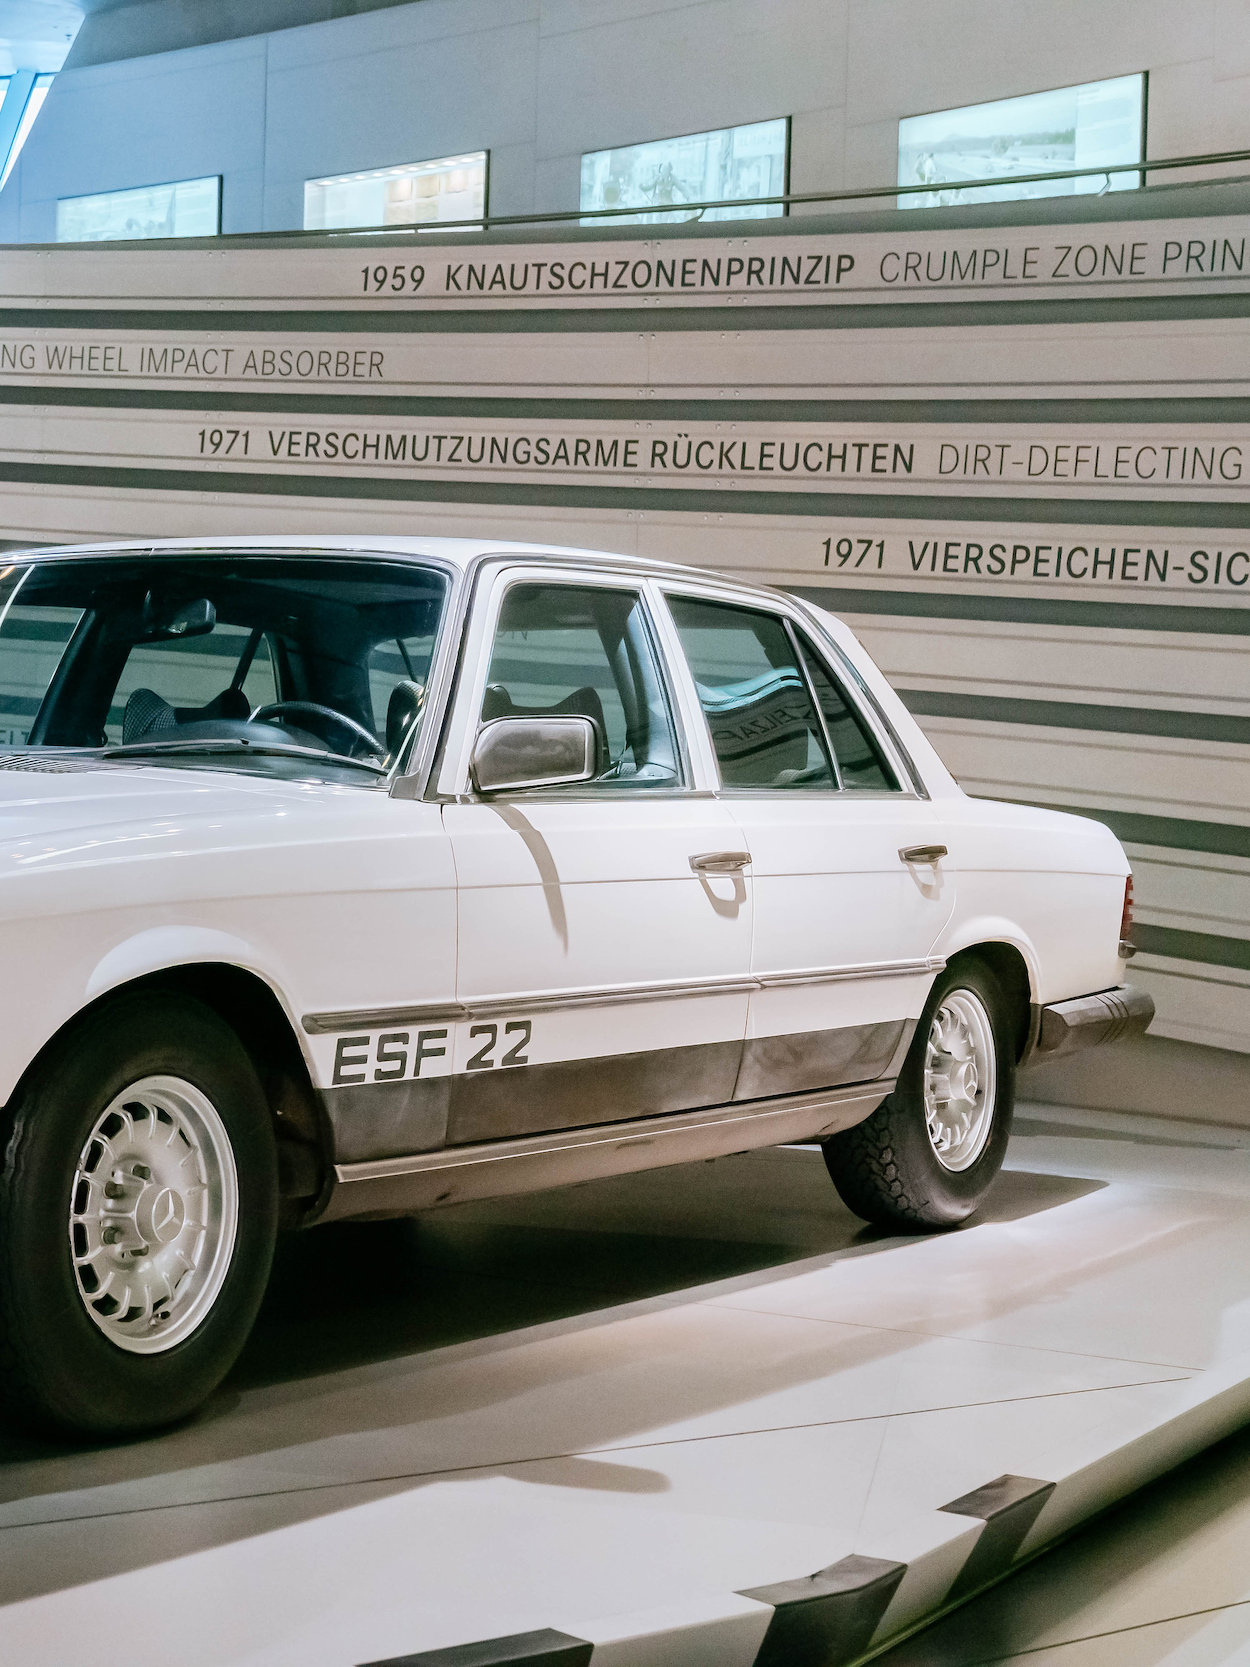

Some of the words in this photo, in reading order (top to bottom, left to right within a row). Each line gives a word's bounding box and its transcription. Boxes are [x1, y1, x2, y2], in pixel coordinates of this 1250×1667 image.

[360, 265, 426, 292] 1959
[445, 254, 855, 291] KNAUTSCHZONENPRINZIP
[879, 246, 1041, 283] CRUMPLE
[1051, 242, 1149, 278] ZONE
[1162, 238, 1246, 274] PRIN
[45, 344, 129, 373] WHEEL
[140, 347, 235, 375] IMPACT
[242, 350, 385, 379] ABSORBER
[197, 428, 251, 456] 1971
[268, 430, 640, 469] VERSCHMUTZUNGSARME
[650, 433, 915, 474] RÜCKLEUCHTEN
[938, 444, 1243, 481] DIRT-DEFLECTING
[822, 537, 886, 569] 1971
[908, 540, 1250, 586] VIERSPEICHEN-SIC
[332, 1028, 449, 1086] ESF
[466, 1020, 533, 1071] 22
